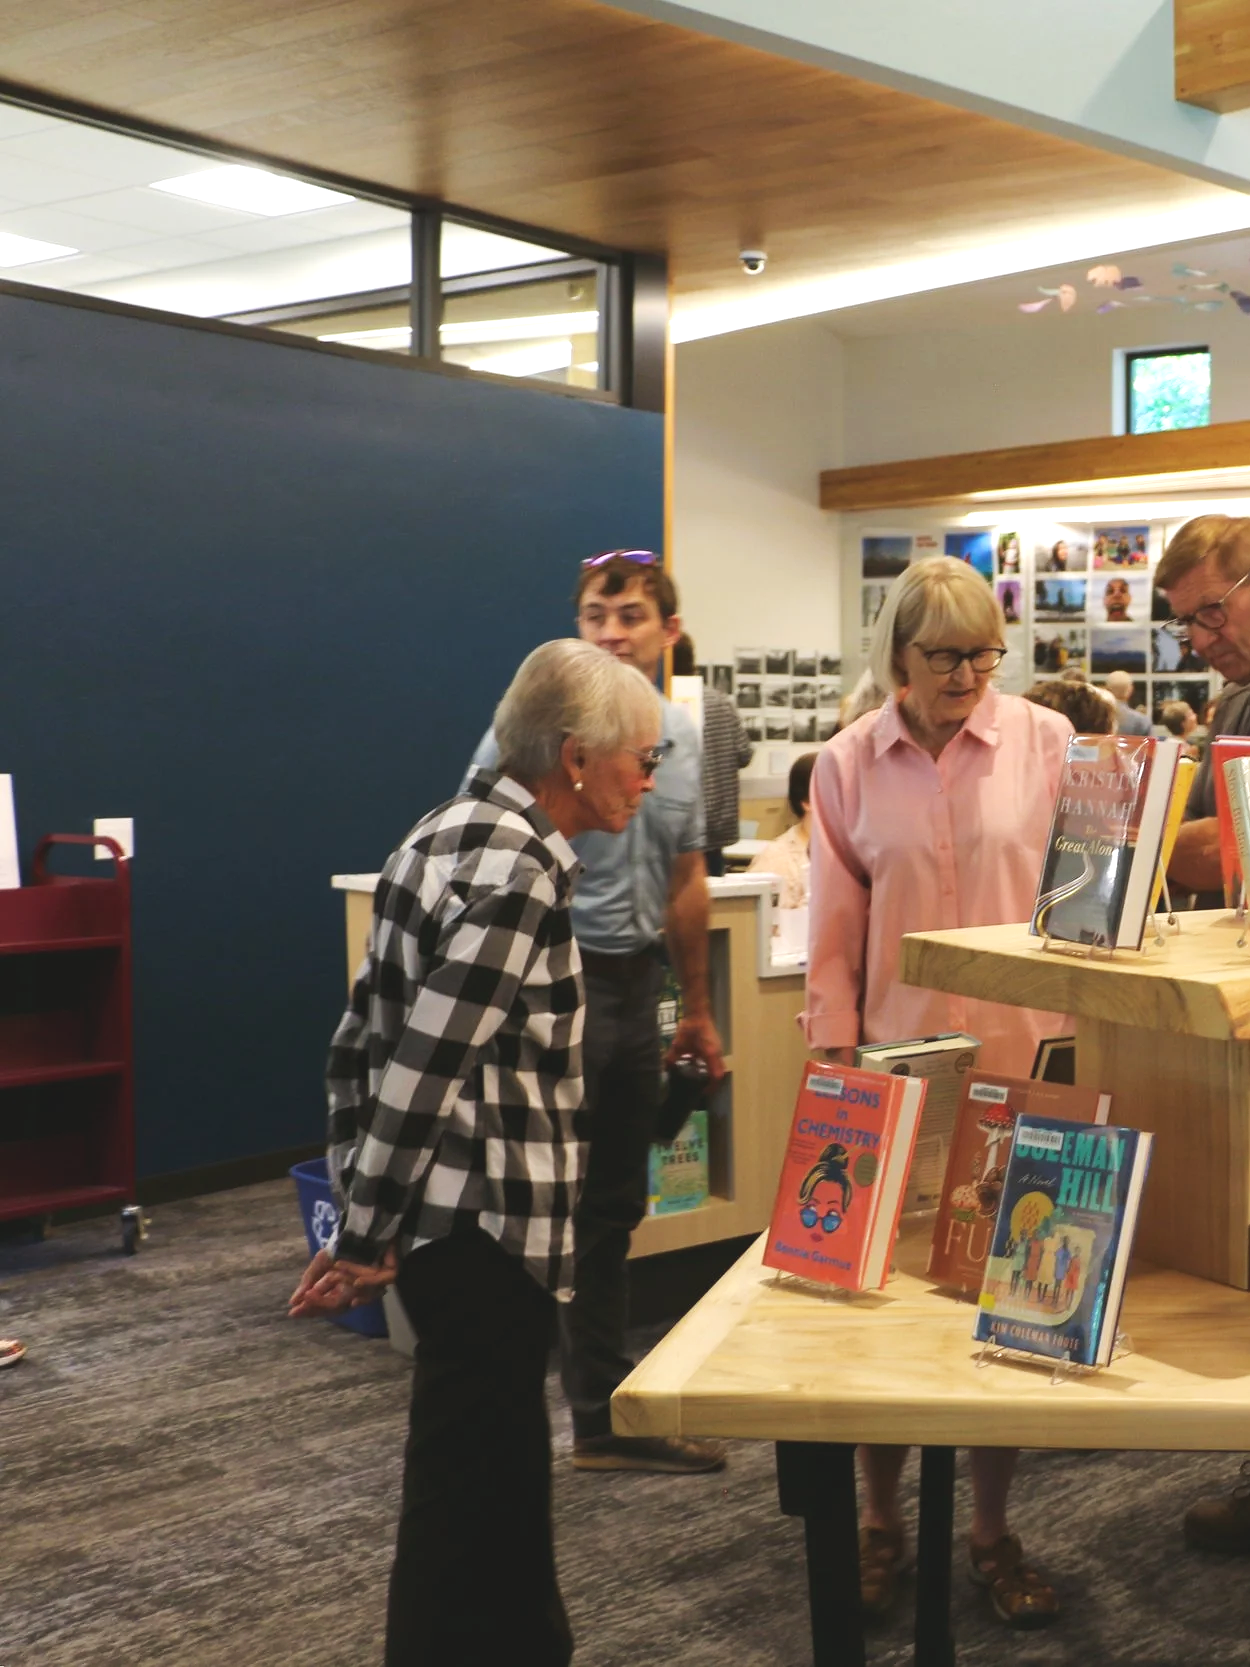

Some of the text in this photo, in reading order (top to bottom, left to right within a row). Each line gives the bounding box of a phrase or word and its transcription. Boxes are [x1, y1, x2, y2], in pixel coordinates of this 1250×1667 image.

[1062, 768, 1137, 790] KRISTIN
[1060, 797, 1134, 820] HANNAH
[1056, 835, 1114, 857] Great Alon
[837, 1108, 848, 1120] in
[797, 1119, 881, 1148] CHEMISTRY
[1055, 1167, 1116, 1213] HILL
